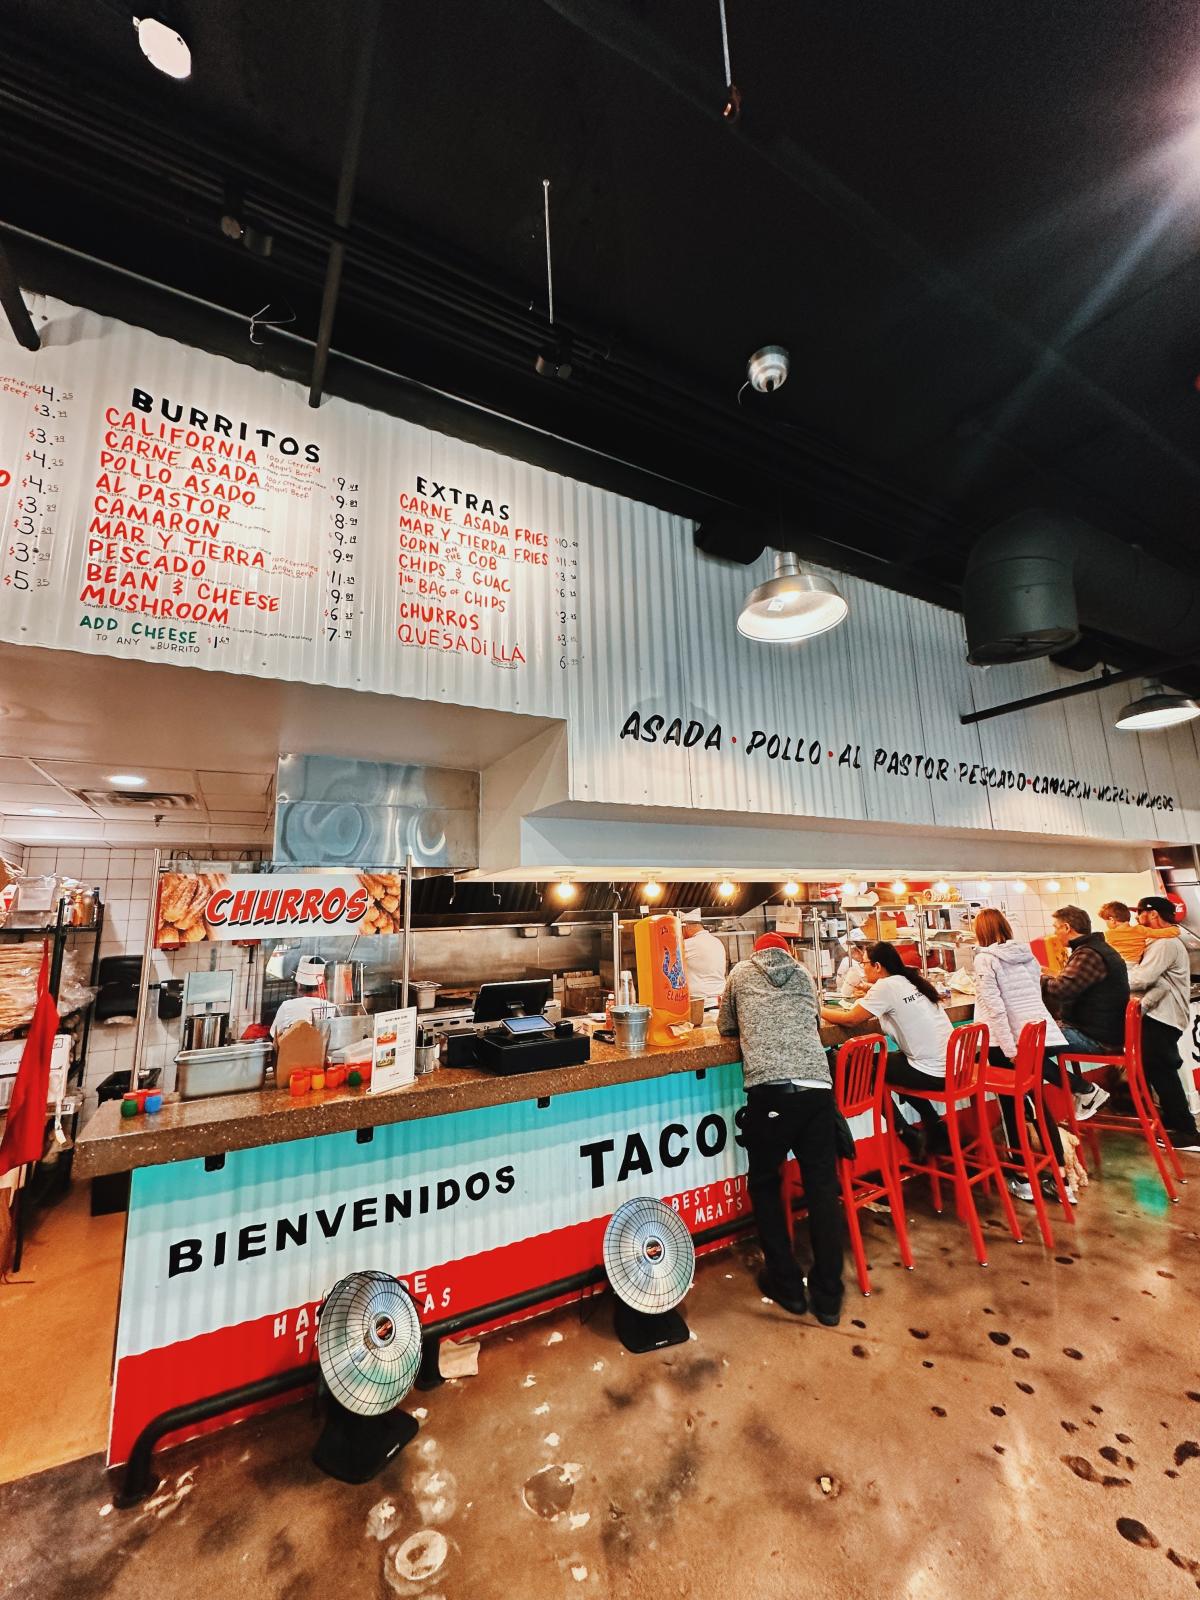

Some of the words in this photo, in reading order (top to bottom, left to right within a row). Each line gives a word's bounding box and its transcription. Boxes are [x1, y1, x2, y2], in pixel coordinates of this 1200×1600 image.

[105, 407, 257, 466] CALIFORNIA
[132, 387, 320, 463] BURRITOS
[101, 450, 172, 485] POLLO
[185, 474, 256, 507] ASADO
[105, 431, 181, 467] CARNE
[191, 455, 261, 489] ASADA
[96, 473, 127, 494] AL
[138, 483, 232, 520] PASTOR
[416, 475, 510, 521] EXTRAS
[95, 495, 220, 539] CAMARON
[400, 493, 453, 522] CARNE
[463, 512, 509, 537] ASADA
[515, 529, 549, 547] FRIES
[88, 539, 207, 577] PESCADO
[90, 516, 145, 544] MAR
[157, 531, 173, 550] Y
[184, 537, 265, 568] TIERRA
[399, 516, 434, 537] MAR
[441, 527, 450, 541] Y
[457, 532, 506, 556] TIERRA
[514, 548, 549, 566] FRIES
[400, 534, 439, 555] CORN
[445, 546, 458, 554] ON
[446, 553, 462, 562] THE
[468, 551, 497, 571] COB
[87, 562, 159, 592] BEAN
[172, 579, 184, 596] &
[197, 583, 281, 612] CHEESE
[399, 553, 446, 577] CHIPS
[472, 571, 511, 593] GUAC
[80, 584, 229, 625] MUSHROOM
[419, 578, 447, 598] BAG
[464, 590, 507, 613] CHIPS
[80, 615, 119, 632] ADD
[132, 622, 198, 645] CHEESE
[400, 602, 479, 630] CHURROS
[96, 633, 108, 641] TO
[117, 636, 142, 646] ANY
[156, 641, 201, 654] BURRITO
[619, 710, 722, 751] ASADA
[745, 730, 822, 765] POLLO
[838, 743, 861, 769] AL
[873, 748, 949, 781] PASTOR
[958, 762, 1027, 792] PESCADO
[1032, 775, 1091, 800] CAMARON
[205, 887, 370, 927] CHURROS
[902, 994, 916, 1004] THE
[671, 1186, 710, 1213] BEST
[694, 1196, 744, 1225] MEATS
[168, 1165, 516, 1279] BIENVENIDOS
